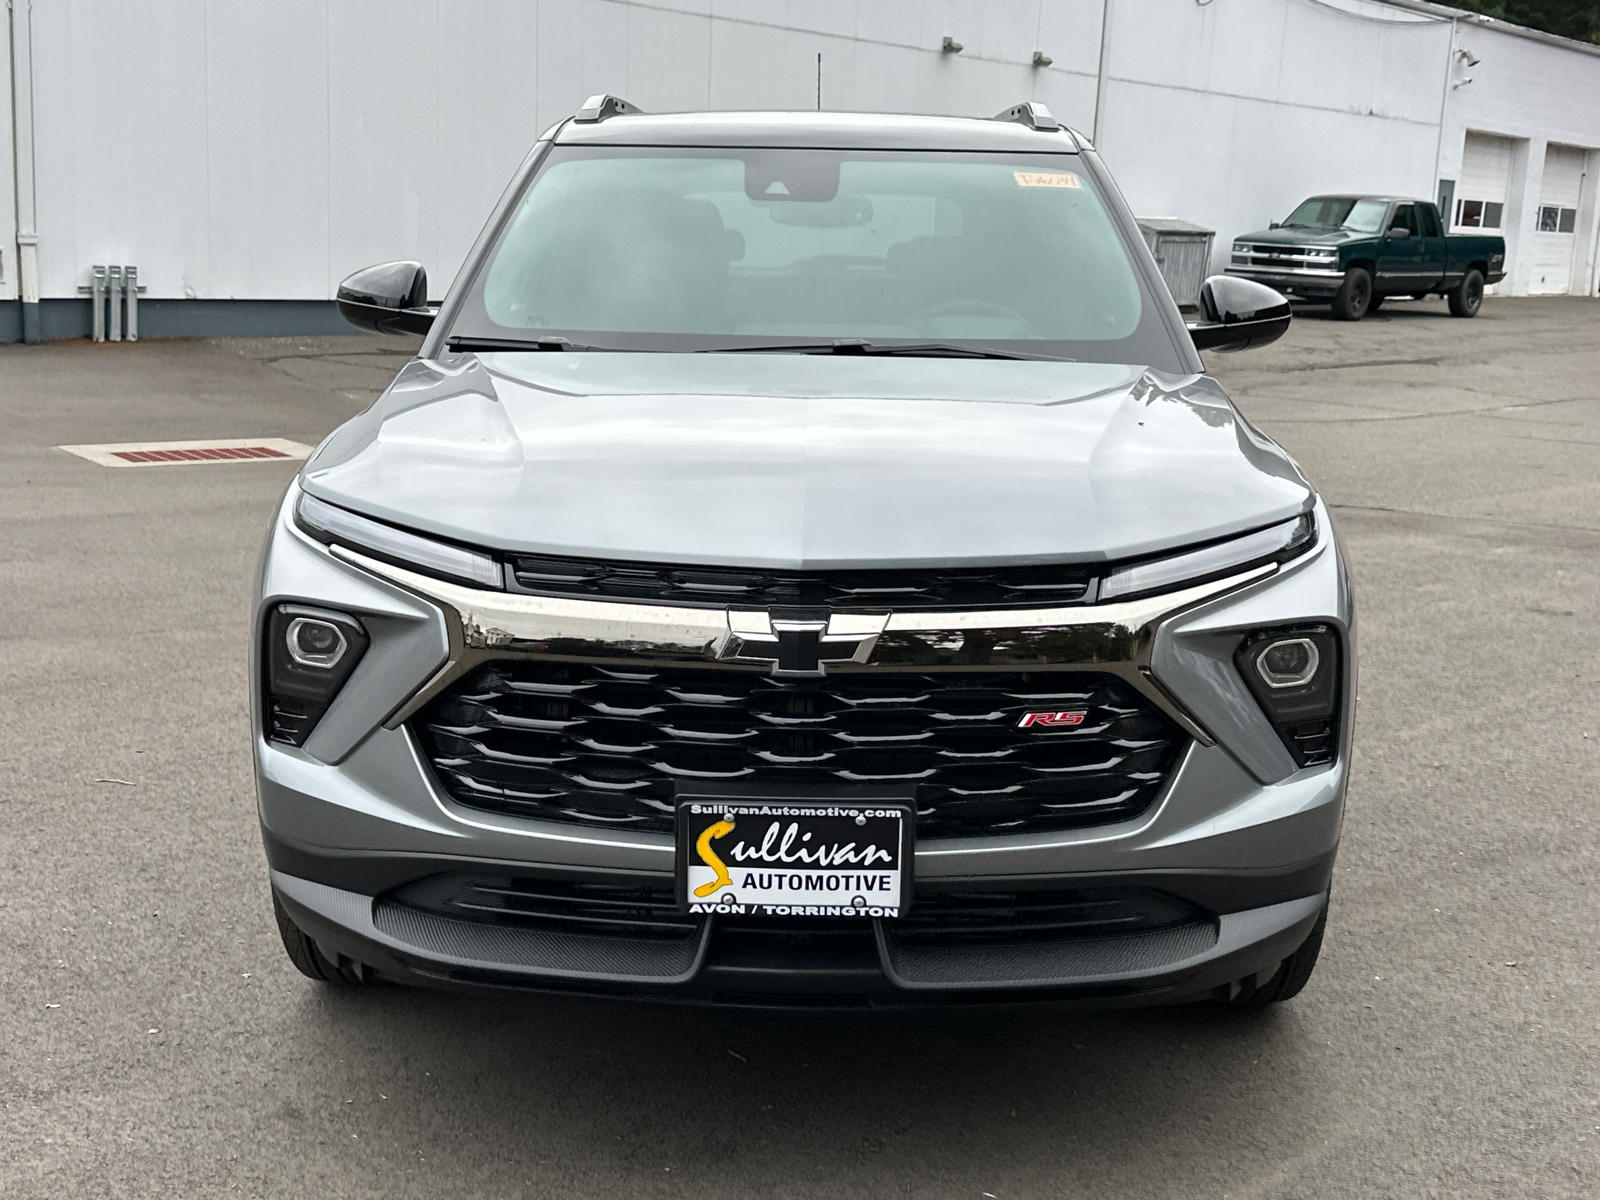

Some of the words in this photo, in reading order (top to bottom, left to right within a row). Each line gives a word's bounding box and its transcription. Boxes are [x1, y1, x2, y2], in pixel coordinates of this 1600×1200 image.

[1018, 711, 1087, 727] RS
[691, 805, 901, 818] SullivanAutomotive.com
[693, 819, 892, 897] Sullivan
[742, 873, 891, 891] AUTOMOTIVE
[689, 904, 746, 914] AVON
[763, 905, 899, 917] TORRINGTON
